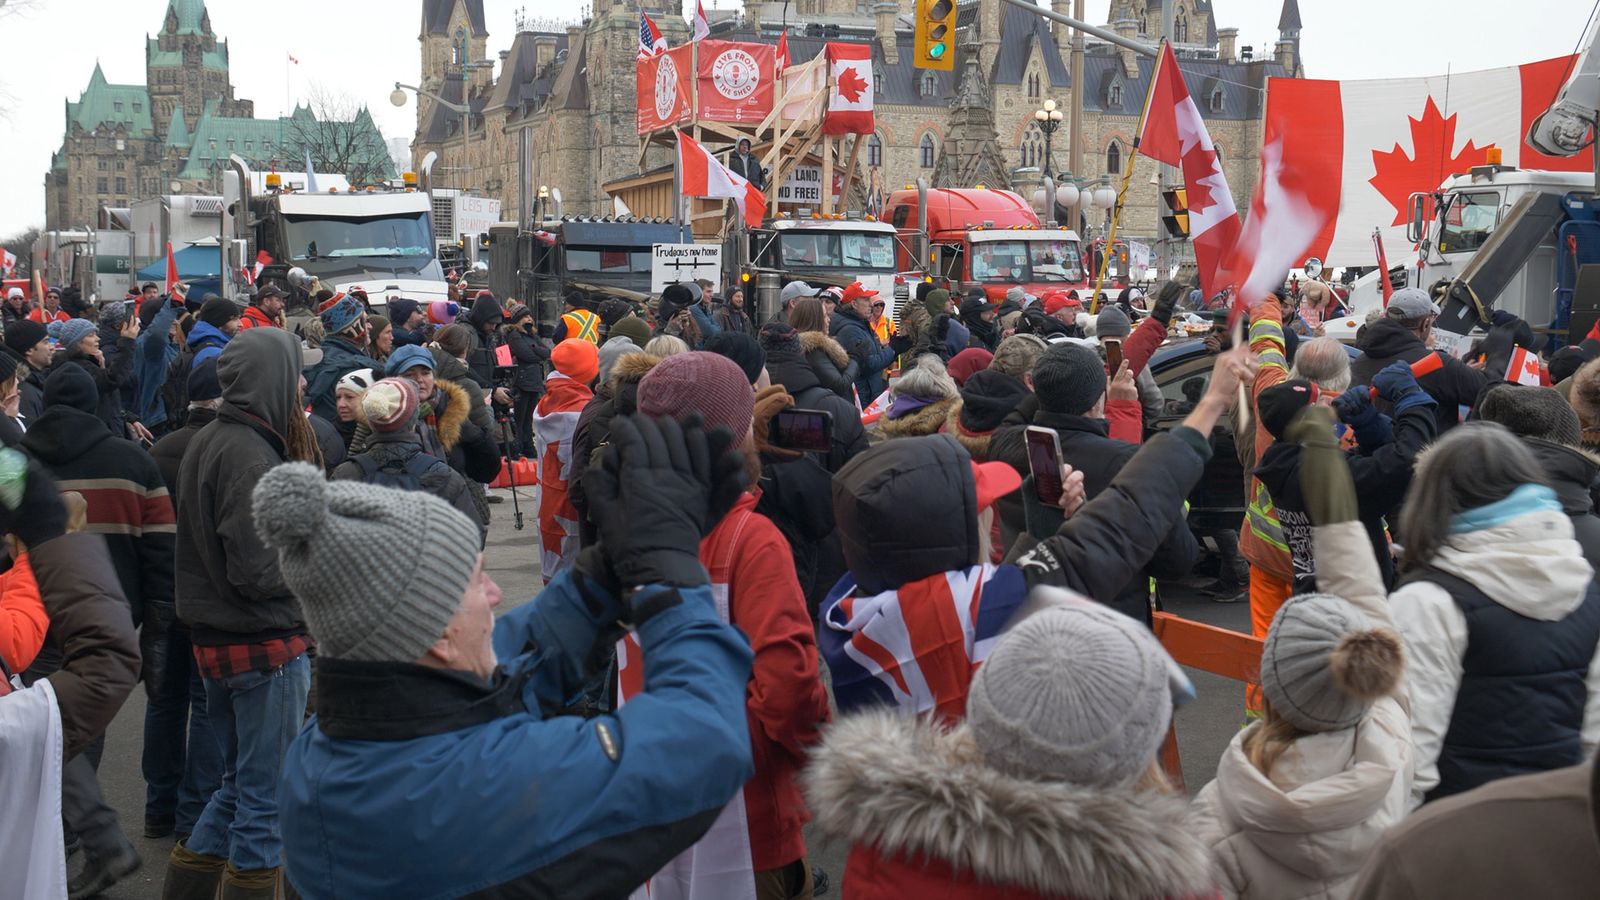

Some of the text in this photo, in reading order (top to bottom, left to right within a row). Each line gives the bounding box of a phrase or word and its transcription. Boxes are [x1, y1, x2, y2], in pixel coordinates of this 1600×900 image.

[716, 52, 755, 72] LIVE FROM
[720, 83, 752, 97] THE SHED
[795, 169, 821, 183] LAND,
[778, 186, 819, 199] ND FREE!
